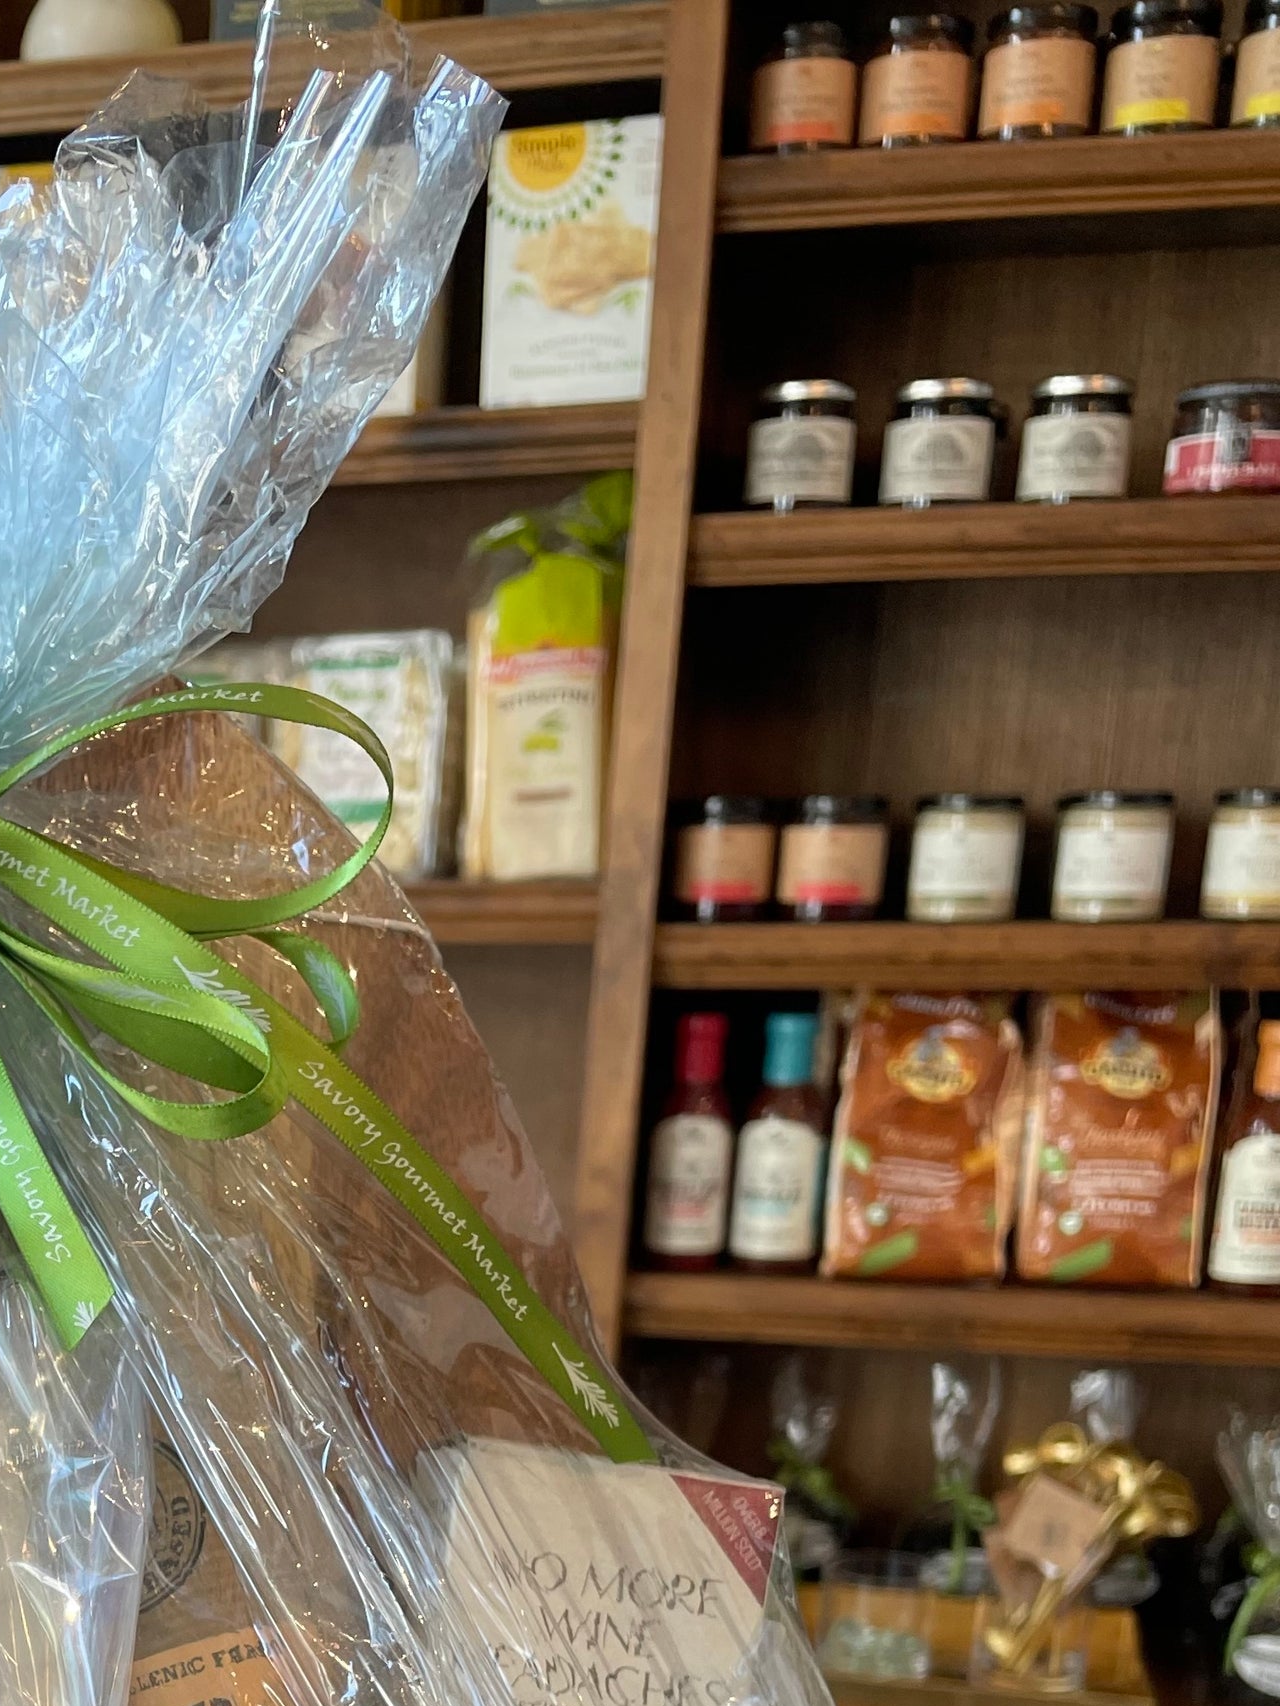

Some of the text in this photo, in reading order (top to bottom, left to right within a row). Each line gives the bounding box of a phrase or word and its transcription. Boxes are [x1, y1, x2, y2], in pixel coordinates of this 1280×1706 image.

[51, 876, 141, 947] Market
[15, 1166, 71, 1264] Savory
[298, 1060, 530, 1322] Savory Gourmet Market
[581, 1563, 724, 1620] MORE
